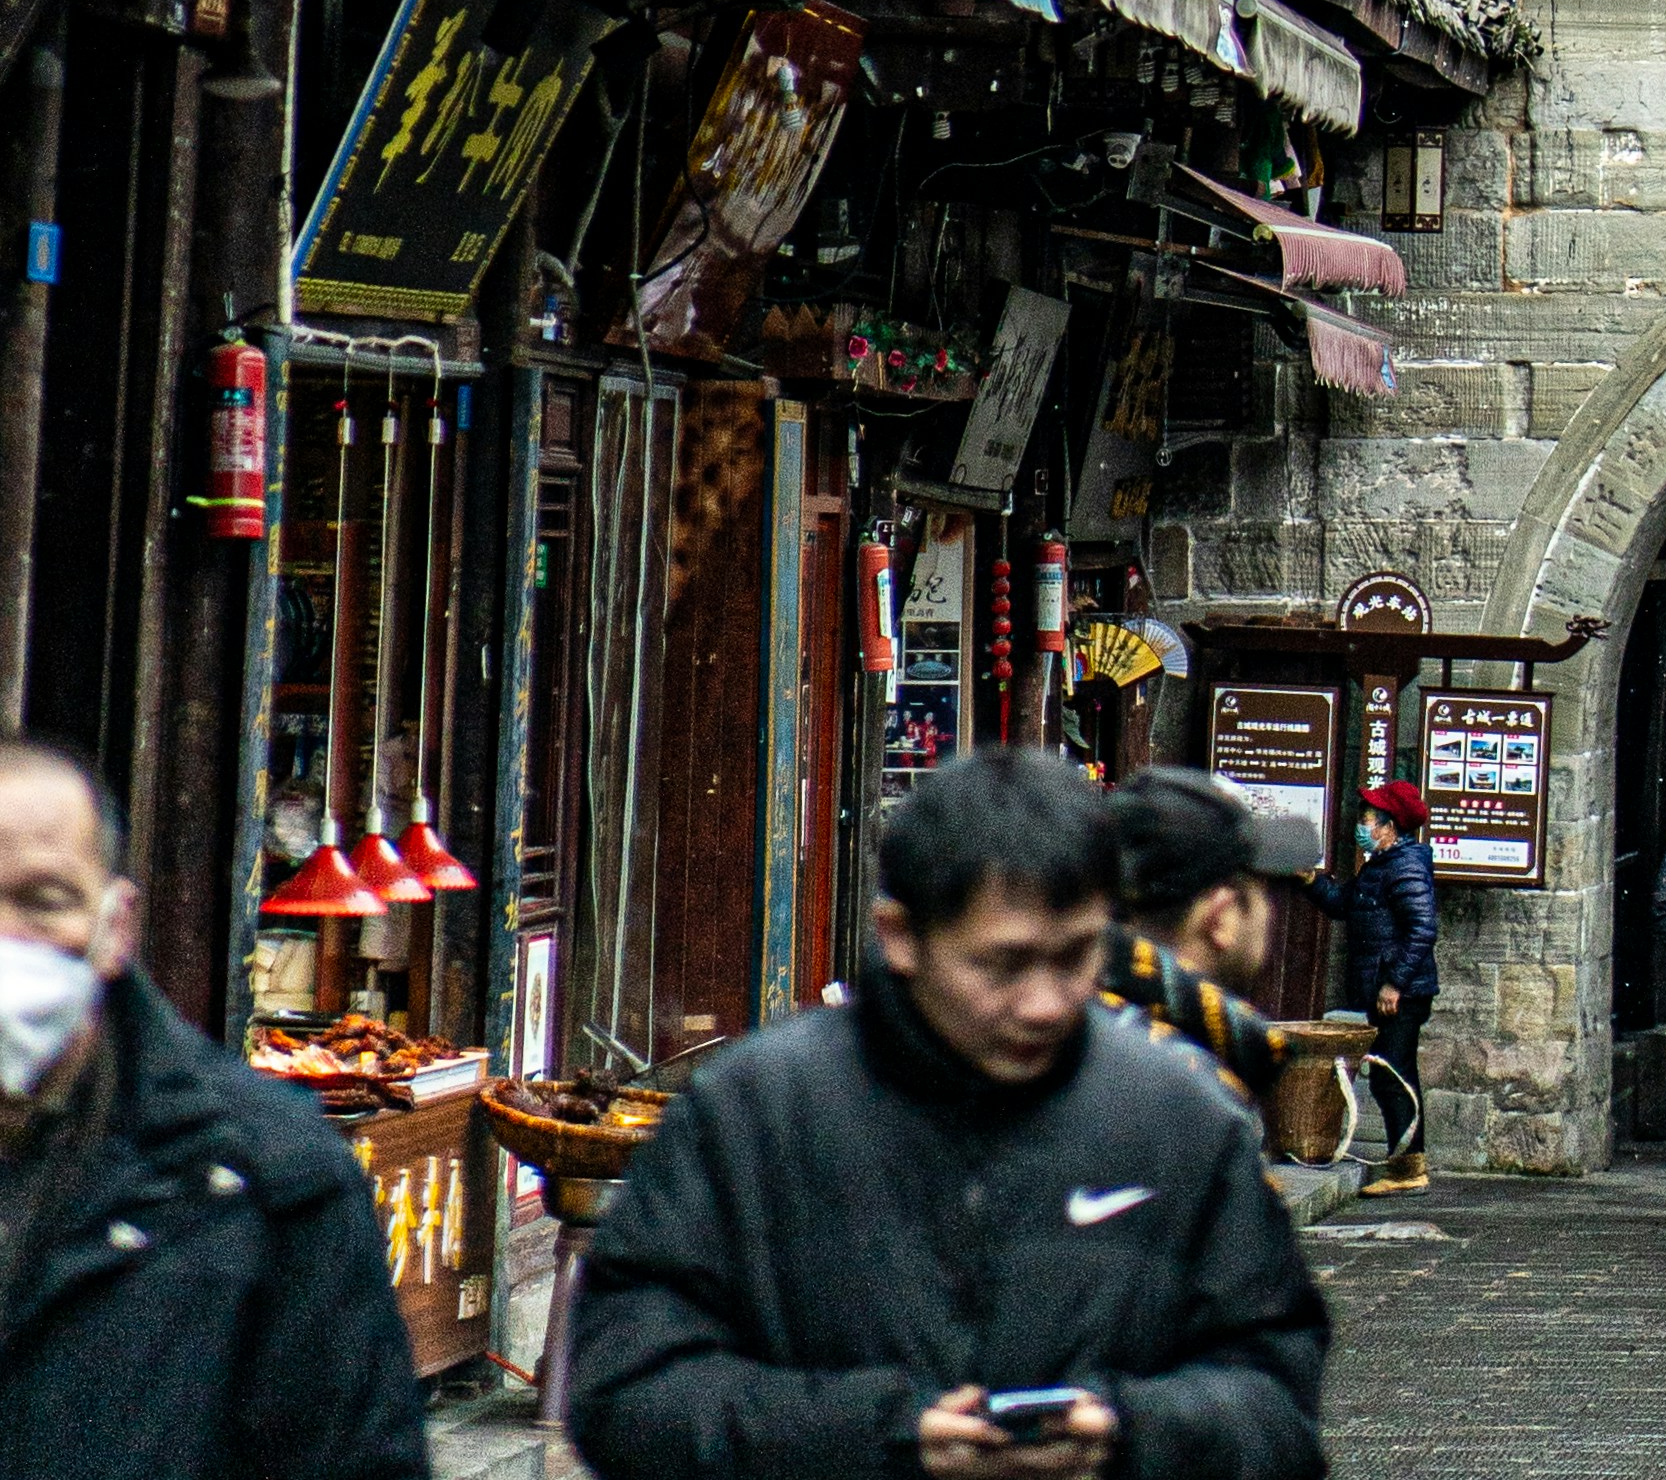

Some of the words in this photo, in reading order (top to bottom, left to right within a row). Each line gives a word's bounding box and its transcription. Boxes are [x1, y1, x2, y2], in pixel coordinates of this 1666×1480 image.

[1352, 595, 1418, 621] 观光车站
[1461, 708, 1534, 727] 古城一票通
